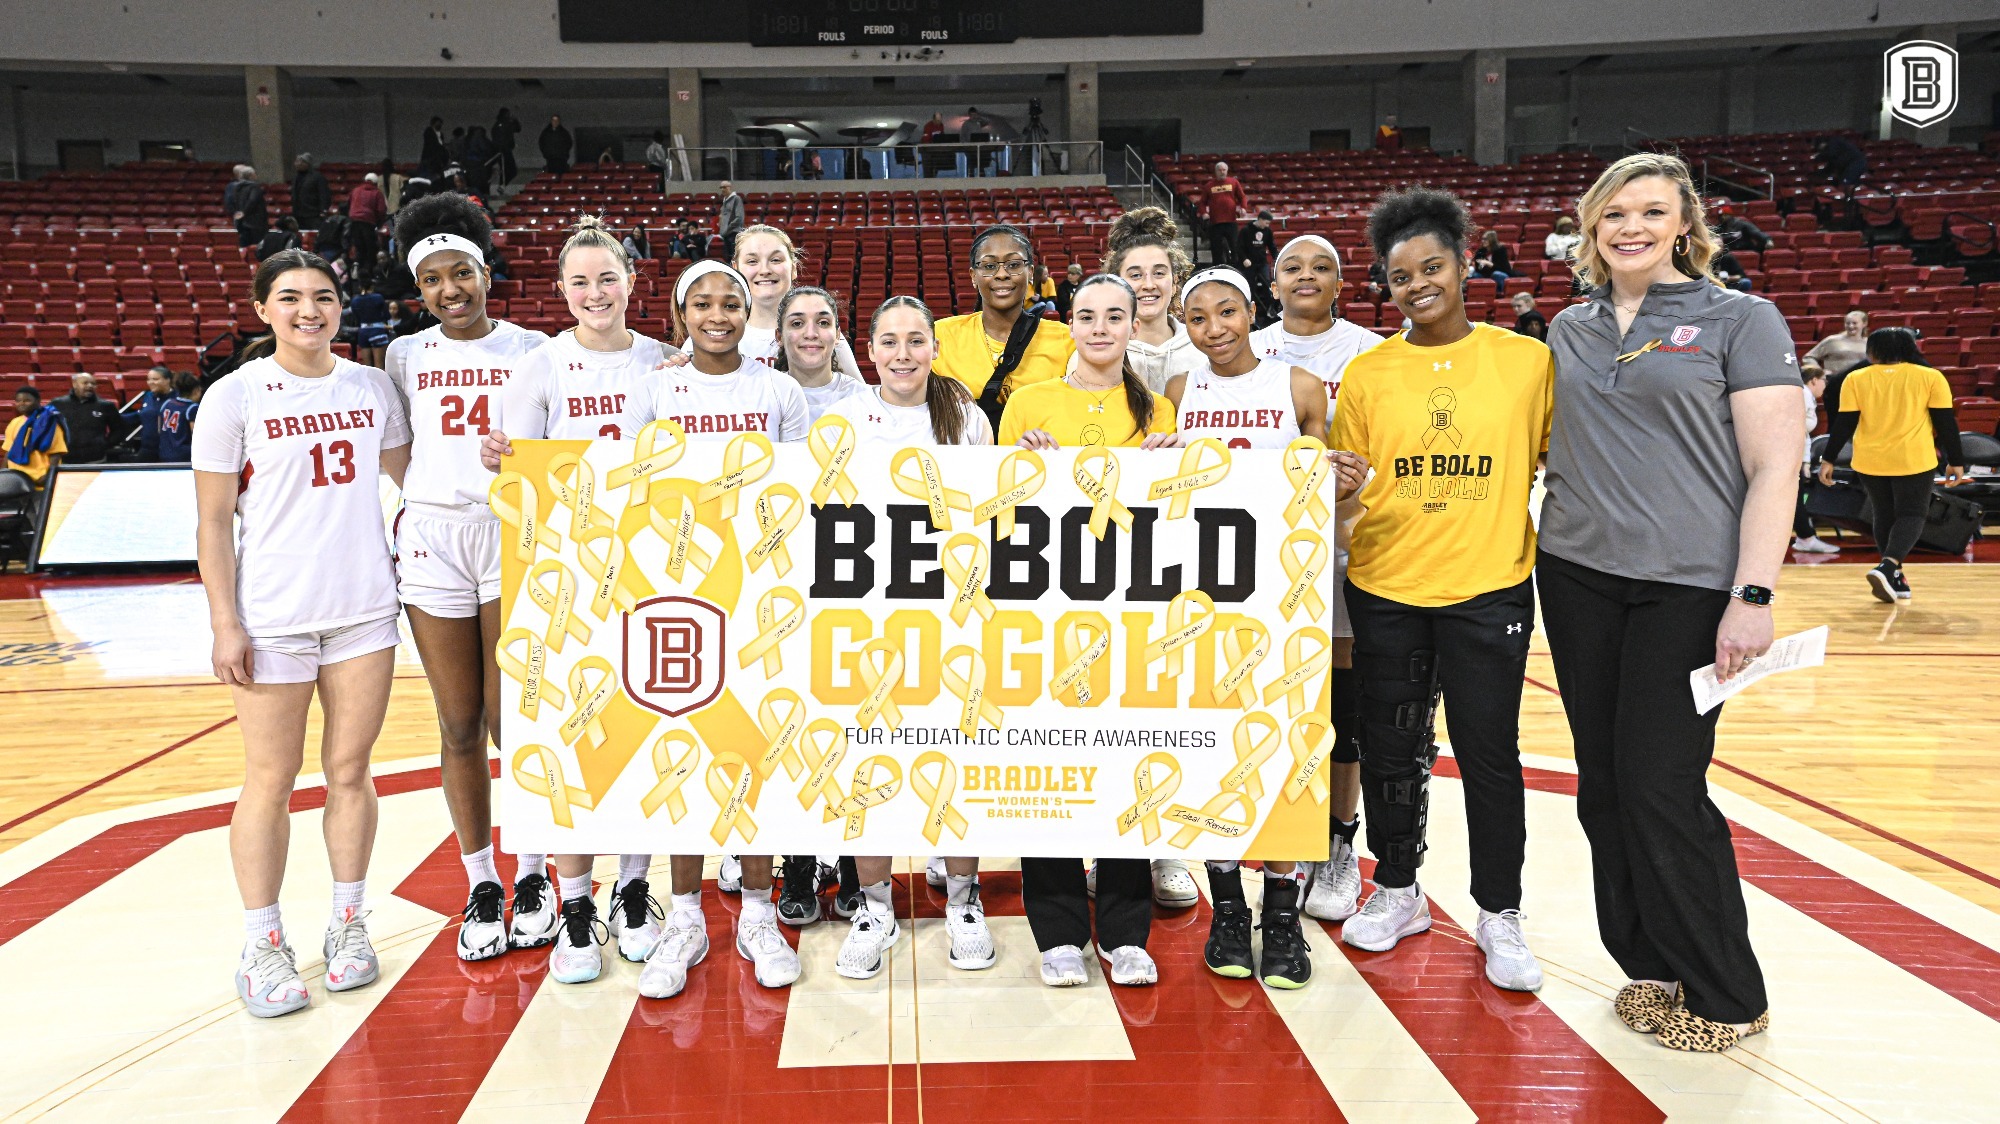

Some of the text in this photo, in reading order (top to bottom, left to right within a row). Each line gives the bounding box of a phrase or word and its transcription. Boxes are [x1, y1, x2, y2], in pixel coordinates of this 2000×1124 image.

[818, 32, 845, 41] FOULS
[864, 25, 895, 35] PERIOD
[921, 30, 948, 40] FOULS
[162, 409, 180, 433] 14
[264, 409, 374, 439] BRADLEY
[440, 395, 490, 435] 24
[1184, 409, 1284, 430] BRADLEY
[309, 440, 355, 487] 13
[1395, 455, 1492, 478] BE BOLD
[1396, 477, 1489, 500] GO GOLD
[810, 503, 1256, 602] BE BOLD
[529, 644, 543, 676] GLASS
[645, 617, 702, 693] B
[810, 609, 941, 706] GO
[982, 610, 1254, 710] GOLD
[845, 728, 883, 744] FOR
[1008, 729, 1086, 746] CANCER
[1093, 730, 1216, 747] AWARENESS
[963, 766, 1097, 791] BRADLEY
[1296, 754, 1320, 787] AVERY
[987, 808, 1072, 818] BASKETBALL
[998, 797, 1062, 806] WOMEN'S
[1205, 818, 1239, 836] Rentals
